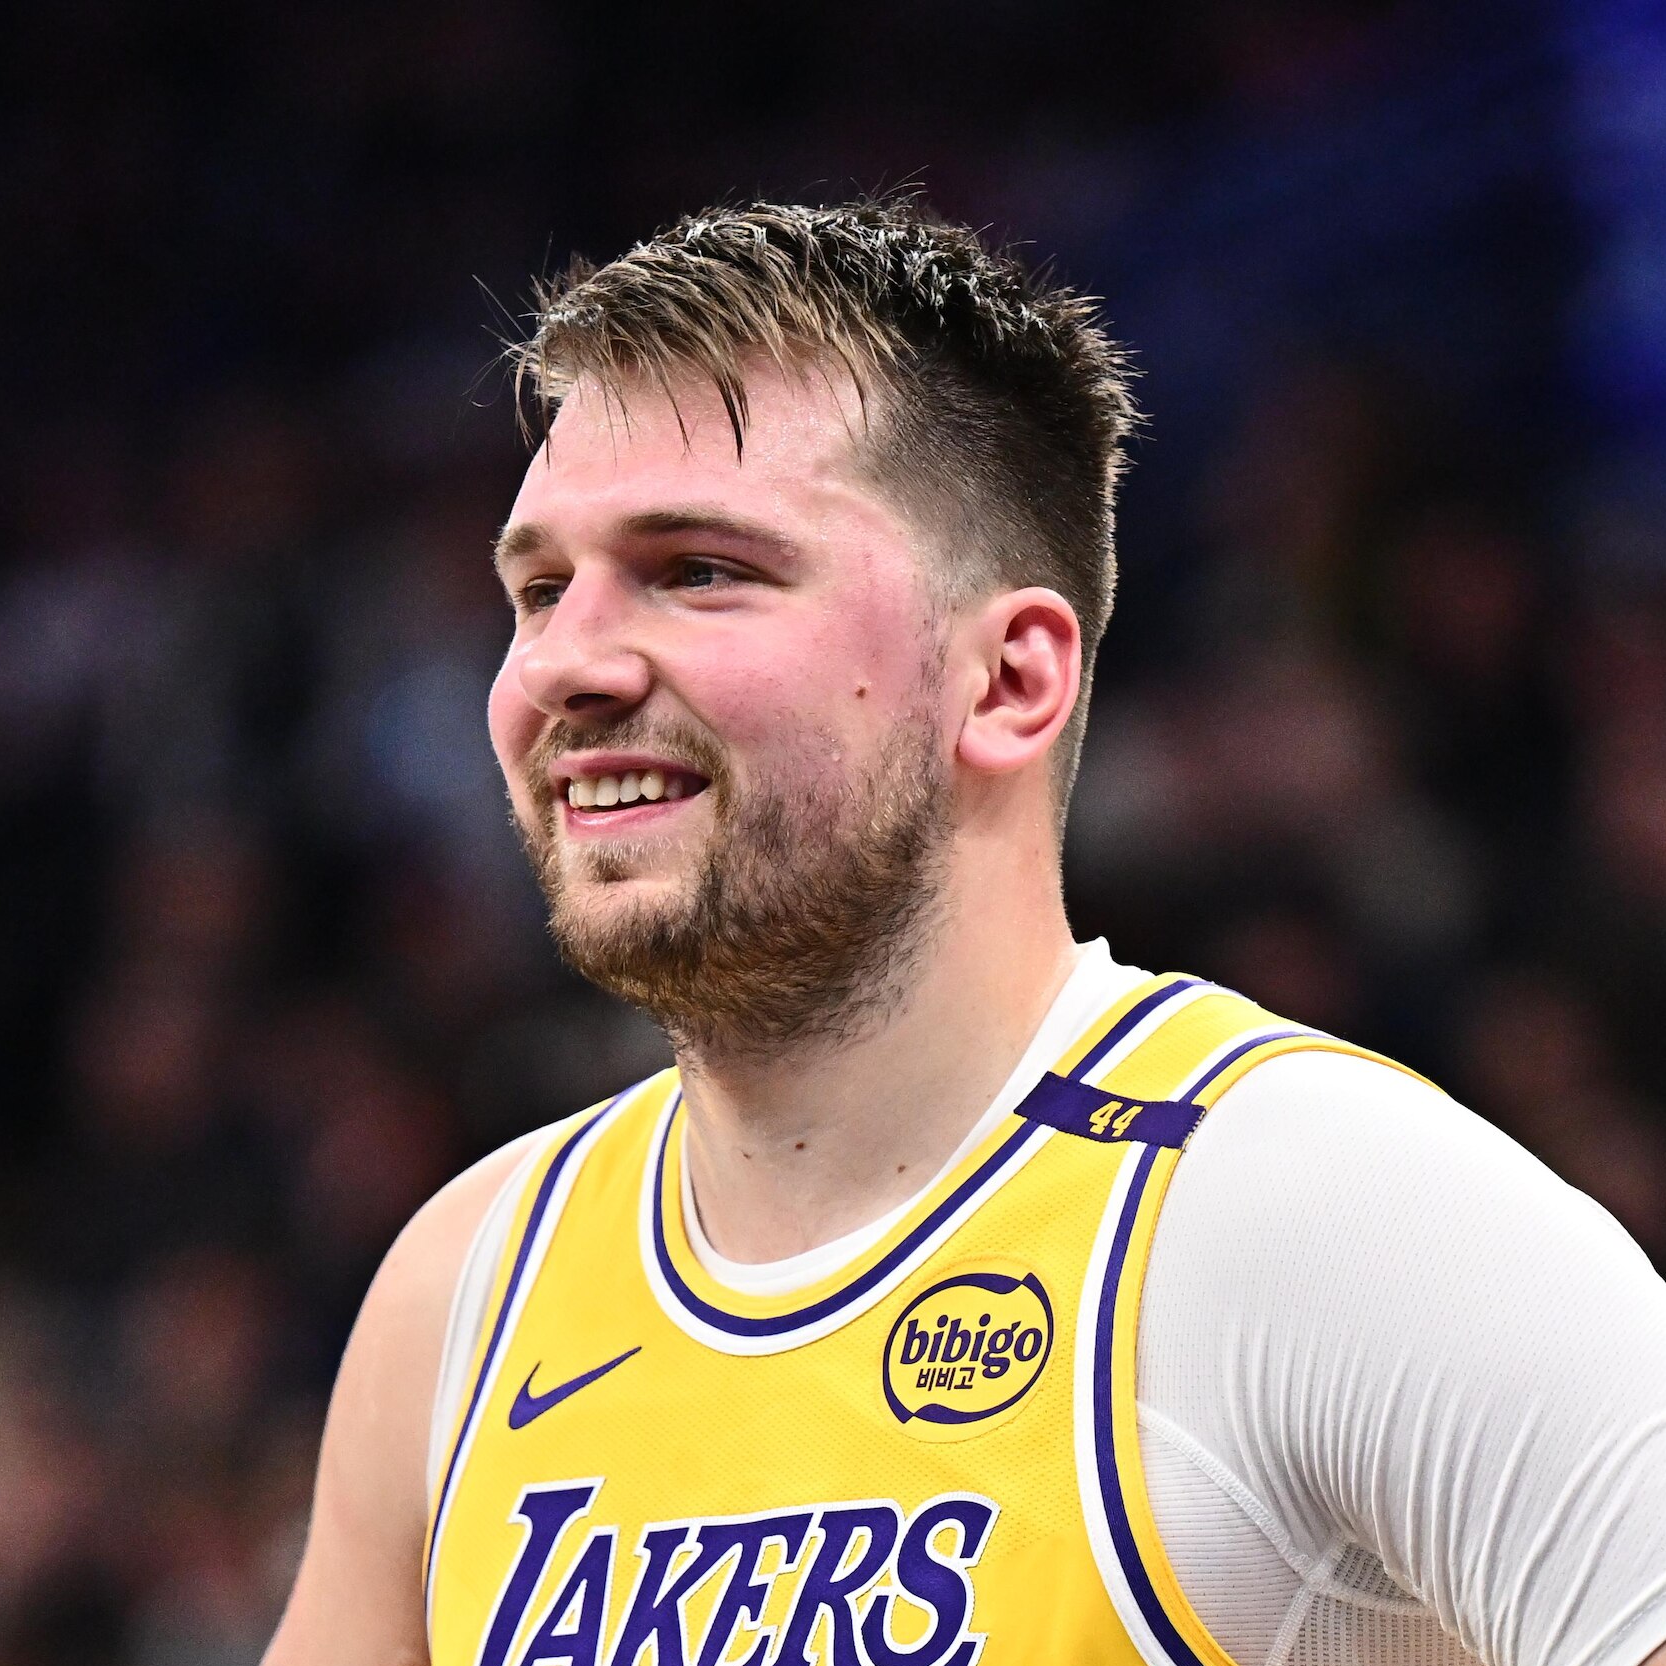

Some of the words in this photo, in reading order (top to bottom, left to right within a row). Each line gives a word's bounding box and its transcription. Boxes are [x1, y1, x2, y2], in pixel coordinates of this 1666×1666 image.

[1088, 1100, 1144, 1138] 44
[900, 1313, 1043, 1379] bibigo
[916, 1366, 976, 1392] 비비고
